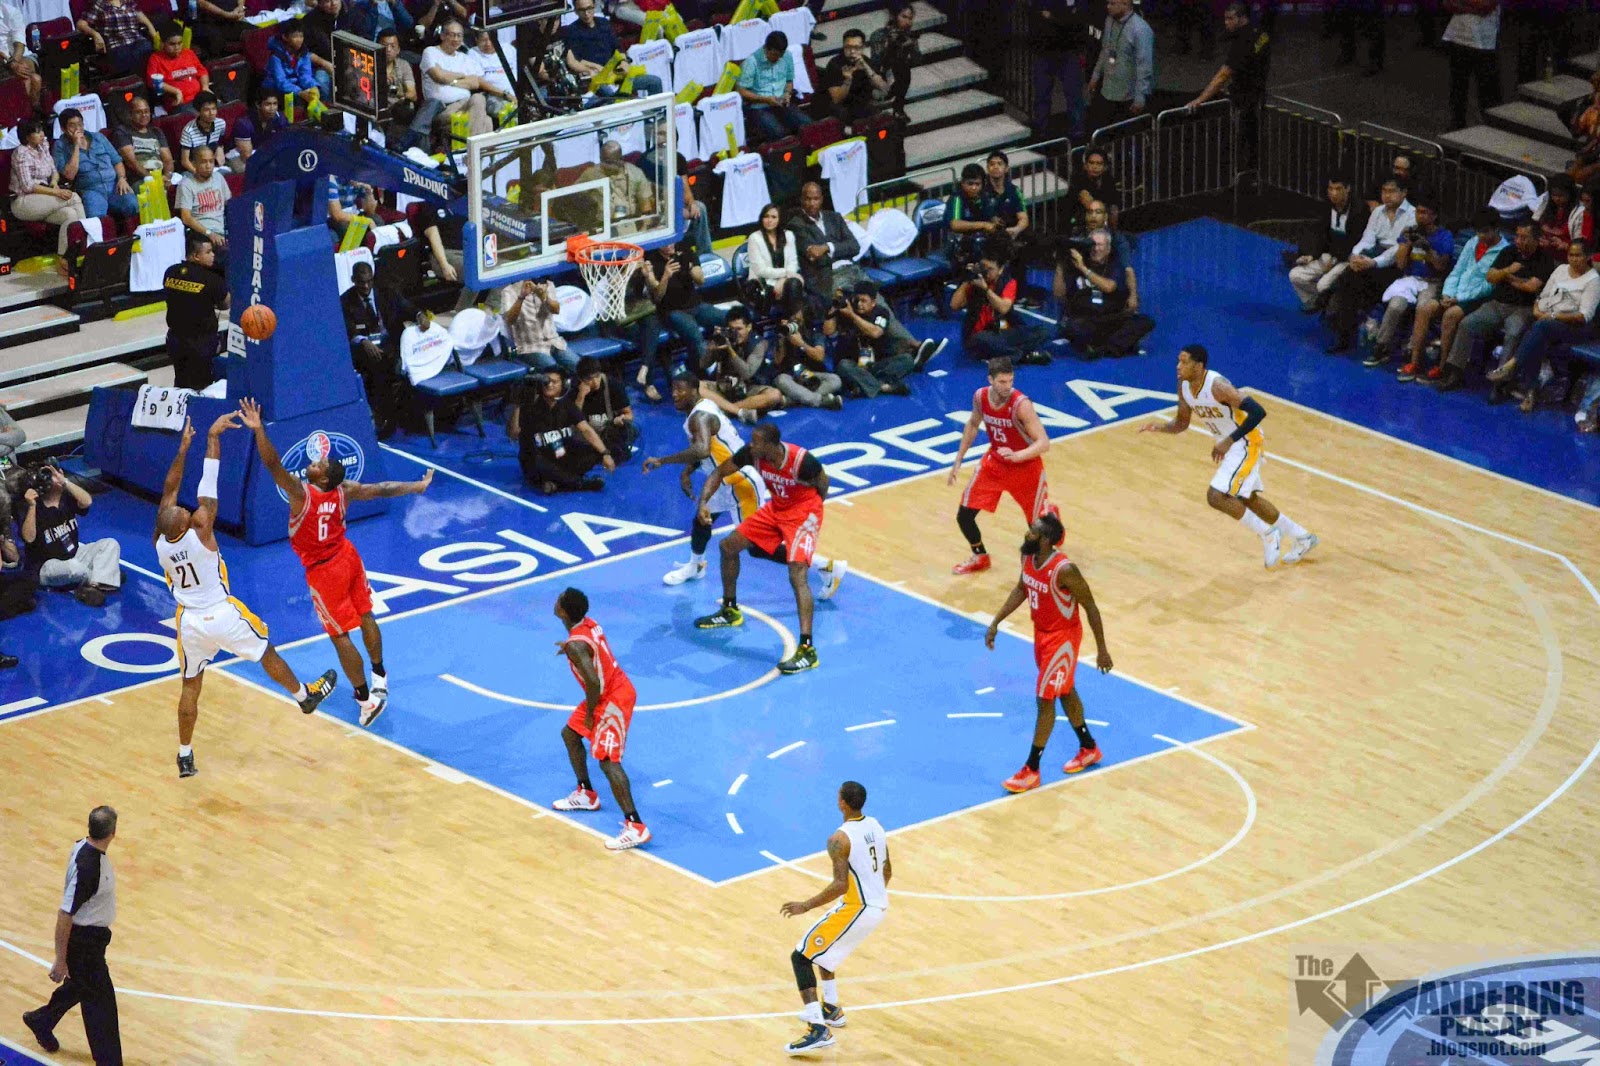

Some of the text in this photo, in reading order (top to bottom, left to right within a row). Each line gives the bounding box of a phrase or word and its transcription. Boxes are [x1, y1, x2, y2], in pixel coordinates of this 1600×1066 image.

[350, 48, 374, 76] 7:32
[360, 76, 371, 101] 9
[403, 167, 448, 200] SPALDING
[490, 209, 527, 232] PHOENIX
[490, 217, 526, 240] Petroleum
[990, 425, 1008, 443] 25
[318, 514, 331, 542] 6
[169, 550, 189, 564] WEST
[364, 511, 686, 614] ASIA
[175, 562, 200, 589] 21
[1028, 587, 1039, 609] 13
[869, 845, 878, 873] 3
